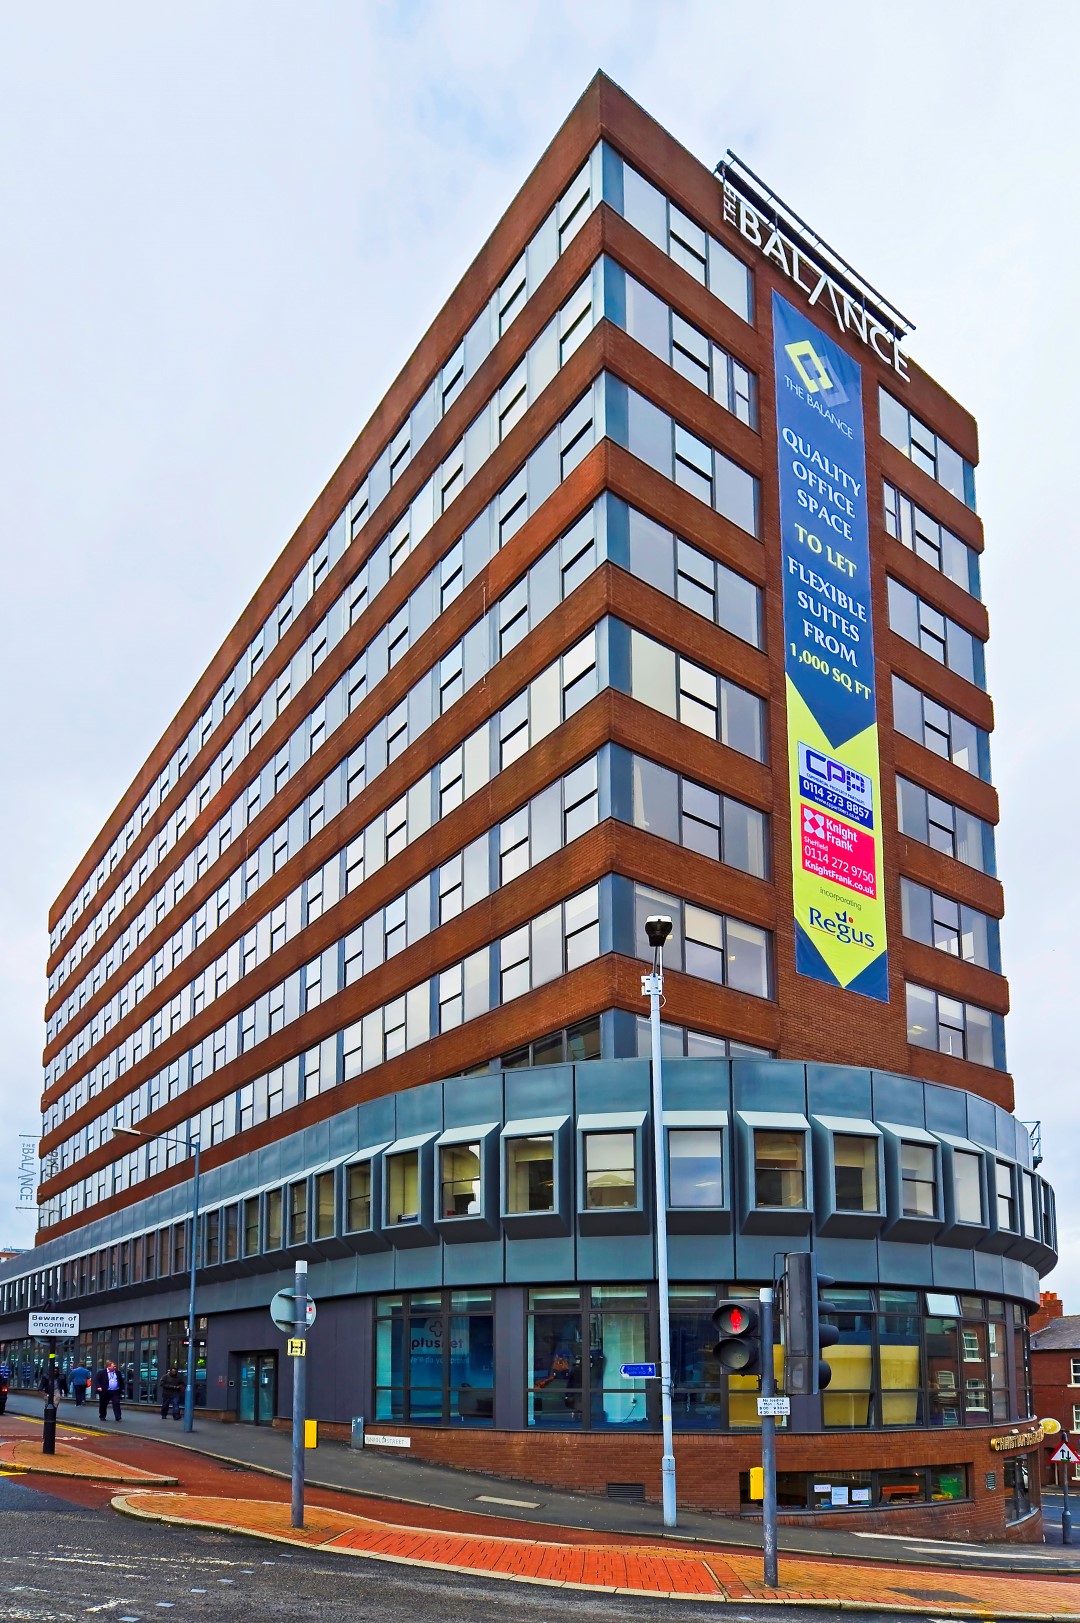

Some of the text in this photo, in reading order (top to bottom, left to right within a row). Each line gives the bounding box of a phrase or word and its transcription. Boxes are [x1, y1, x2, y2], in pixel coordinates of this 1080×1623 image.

[723, 184, 737, 227] THE
[739, 201, 911, 382] BALANCE
[784, 374, 854, 440] THE BALANCE
[782, 427, 862, 497] QUALITY
[792, 460, 856, 519] OFFICE
[797, 488, 853, 541] SPACE
[794, 522, 857, 578] TO LET
[787, 555, 867, 623] FLEXIBLE
[797, 590, 860, 642] SUITES
[802, 618, 858, 668] FROM
[790, 642, 872, 700] 1,000 SQ FT
[803, 779, 870, 819] 0114 273 8857
[803, 835, 829, 852] Sheffield
[826, 818, 858, 843] Knight
[826, 831, 854, 853] Frank
[804, 845, 874, 884] 0114 272 9750
[804, 859, 875, 896] KnightFrank.co.uk
[819, 886, 862, 912] incorporating
[809, 906, 875, 948] Regus
[18, 1147, 36, 1201] BALANCE
[290, 1340, 303, 1355] H
[411, 1337, 464, 1351] pluset
